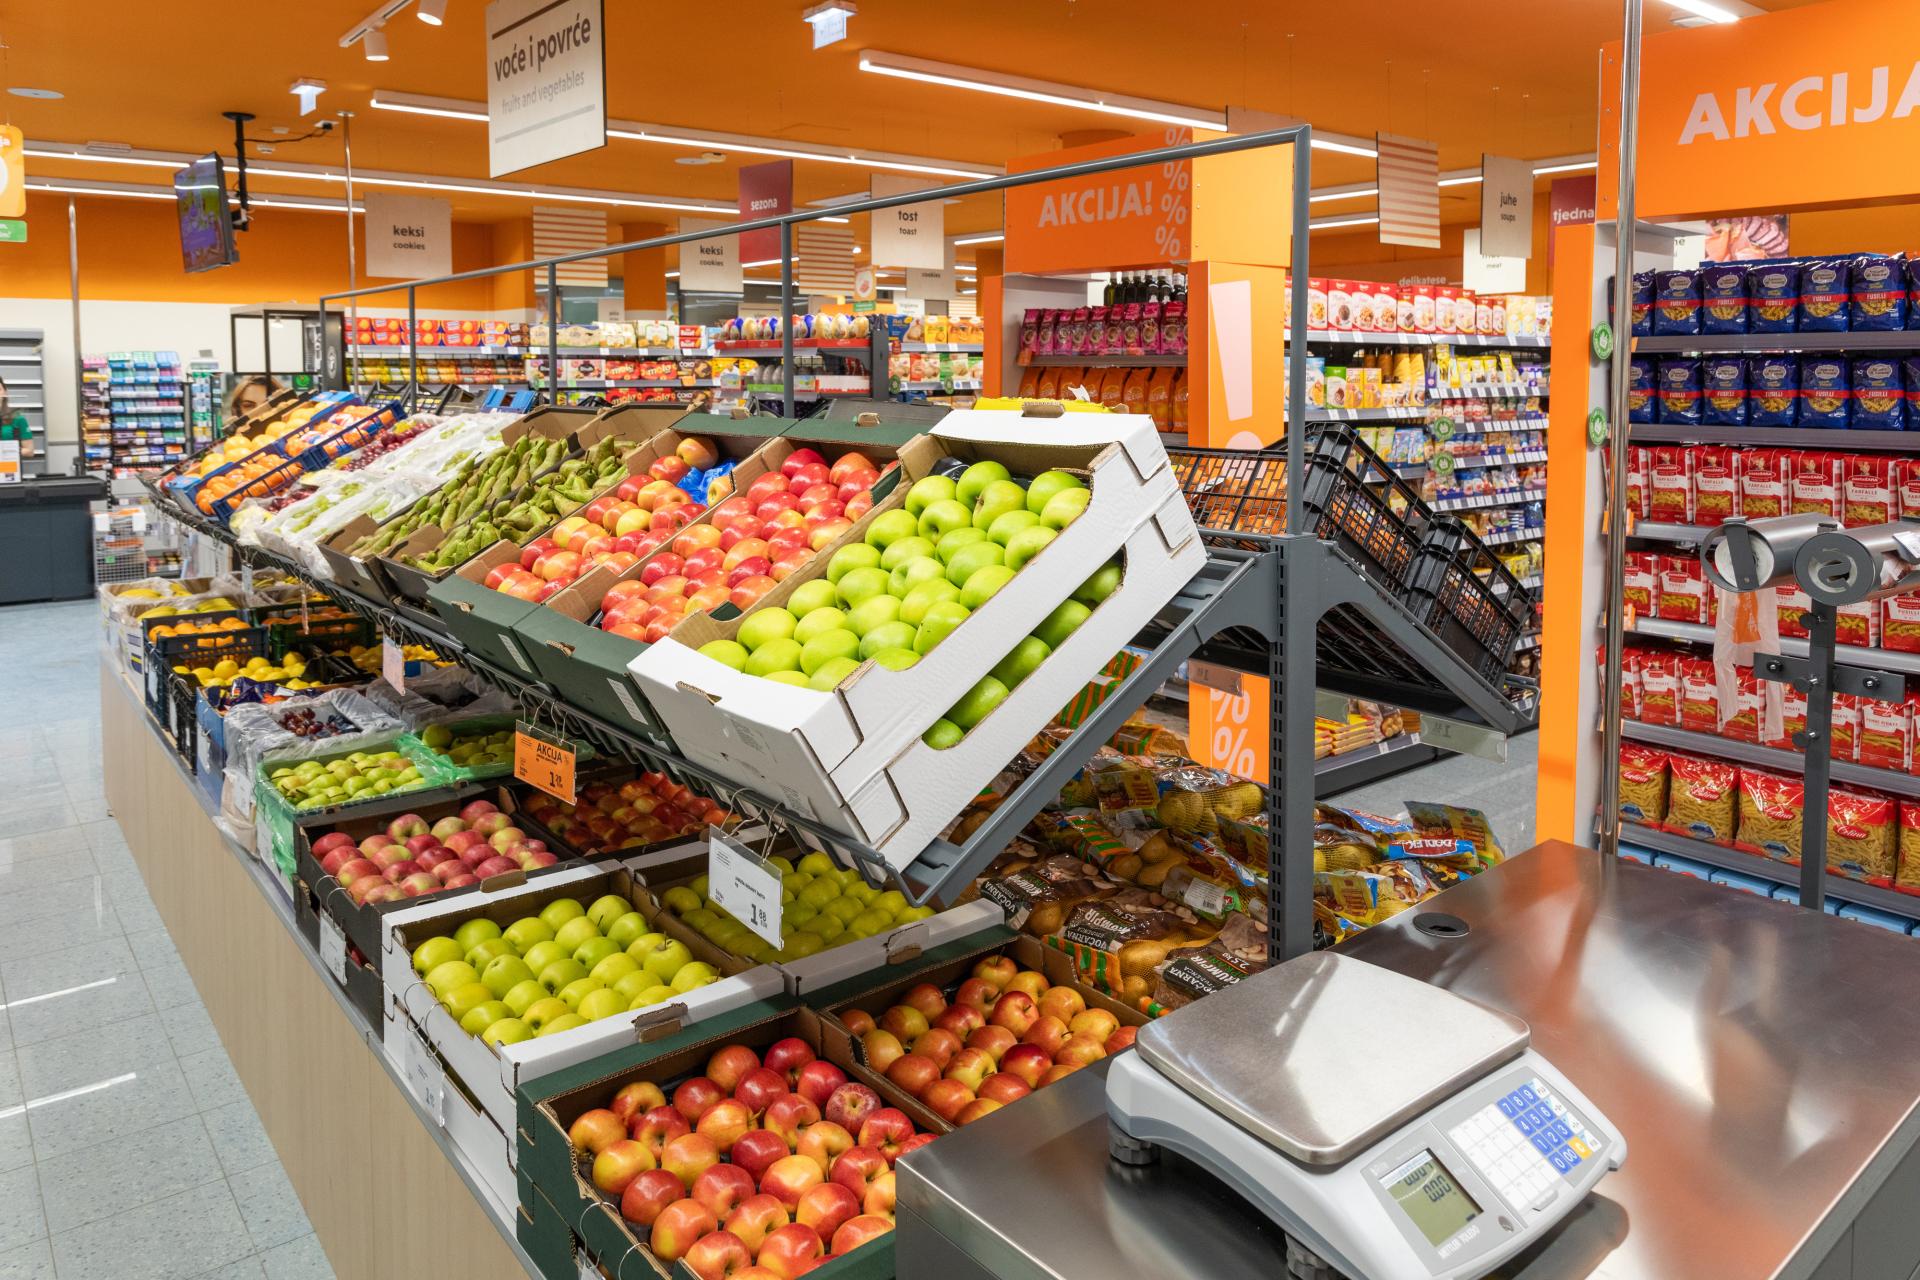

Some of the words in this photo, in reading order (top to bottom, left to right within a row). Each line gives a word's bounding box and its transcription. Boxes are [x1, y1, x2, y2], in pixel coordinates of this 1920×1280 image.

[494, 43, 527, 82] voće
[529, 35, 534, 67] i
[537, 13, 591, 72] povrće
[502, 95, 521, 115] fruits
[522, 85, 537, 108] and
[538, 70, 585, 102] vegetables
[750, 198, 778, 211] sezona
[1037, 181, 1153, 228] AKCIJA!
[1500, 192, 1518, 208] juhe
[898, 210, 918, 222] tost
[1553, 207, 1595, 224] tjedna
[393, 224, 425, 238] keksi
[899, 227, 917, 236] toast
[392, 242, 425, 250] cookies
[700, 245, 724, 256] keksi
[1399, 276, 1447, 287] delikatese
[537, 743, 563, 764] AKCIJA
[1502, 1102, 1512, 1113] 7
[1513, 1096, 1524, 1107] 8
[1523, 1089, 1534, 1100] 9
[1520, 1120, 1530, 1131] 4
[1530, 1113, 1541, 1124] 5
[1540, 1106, 1551, 1117] 6
[1537, 1139, 1548, 1150] 1
[1547, 1132, 1559, 1143] 2
[1557, 1124, 1568, 1135] 3
[1554, 1157, 1565, 1169] 0
